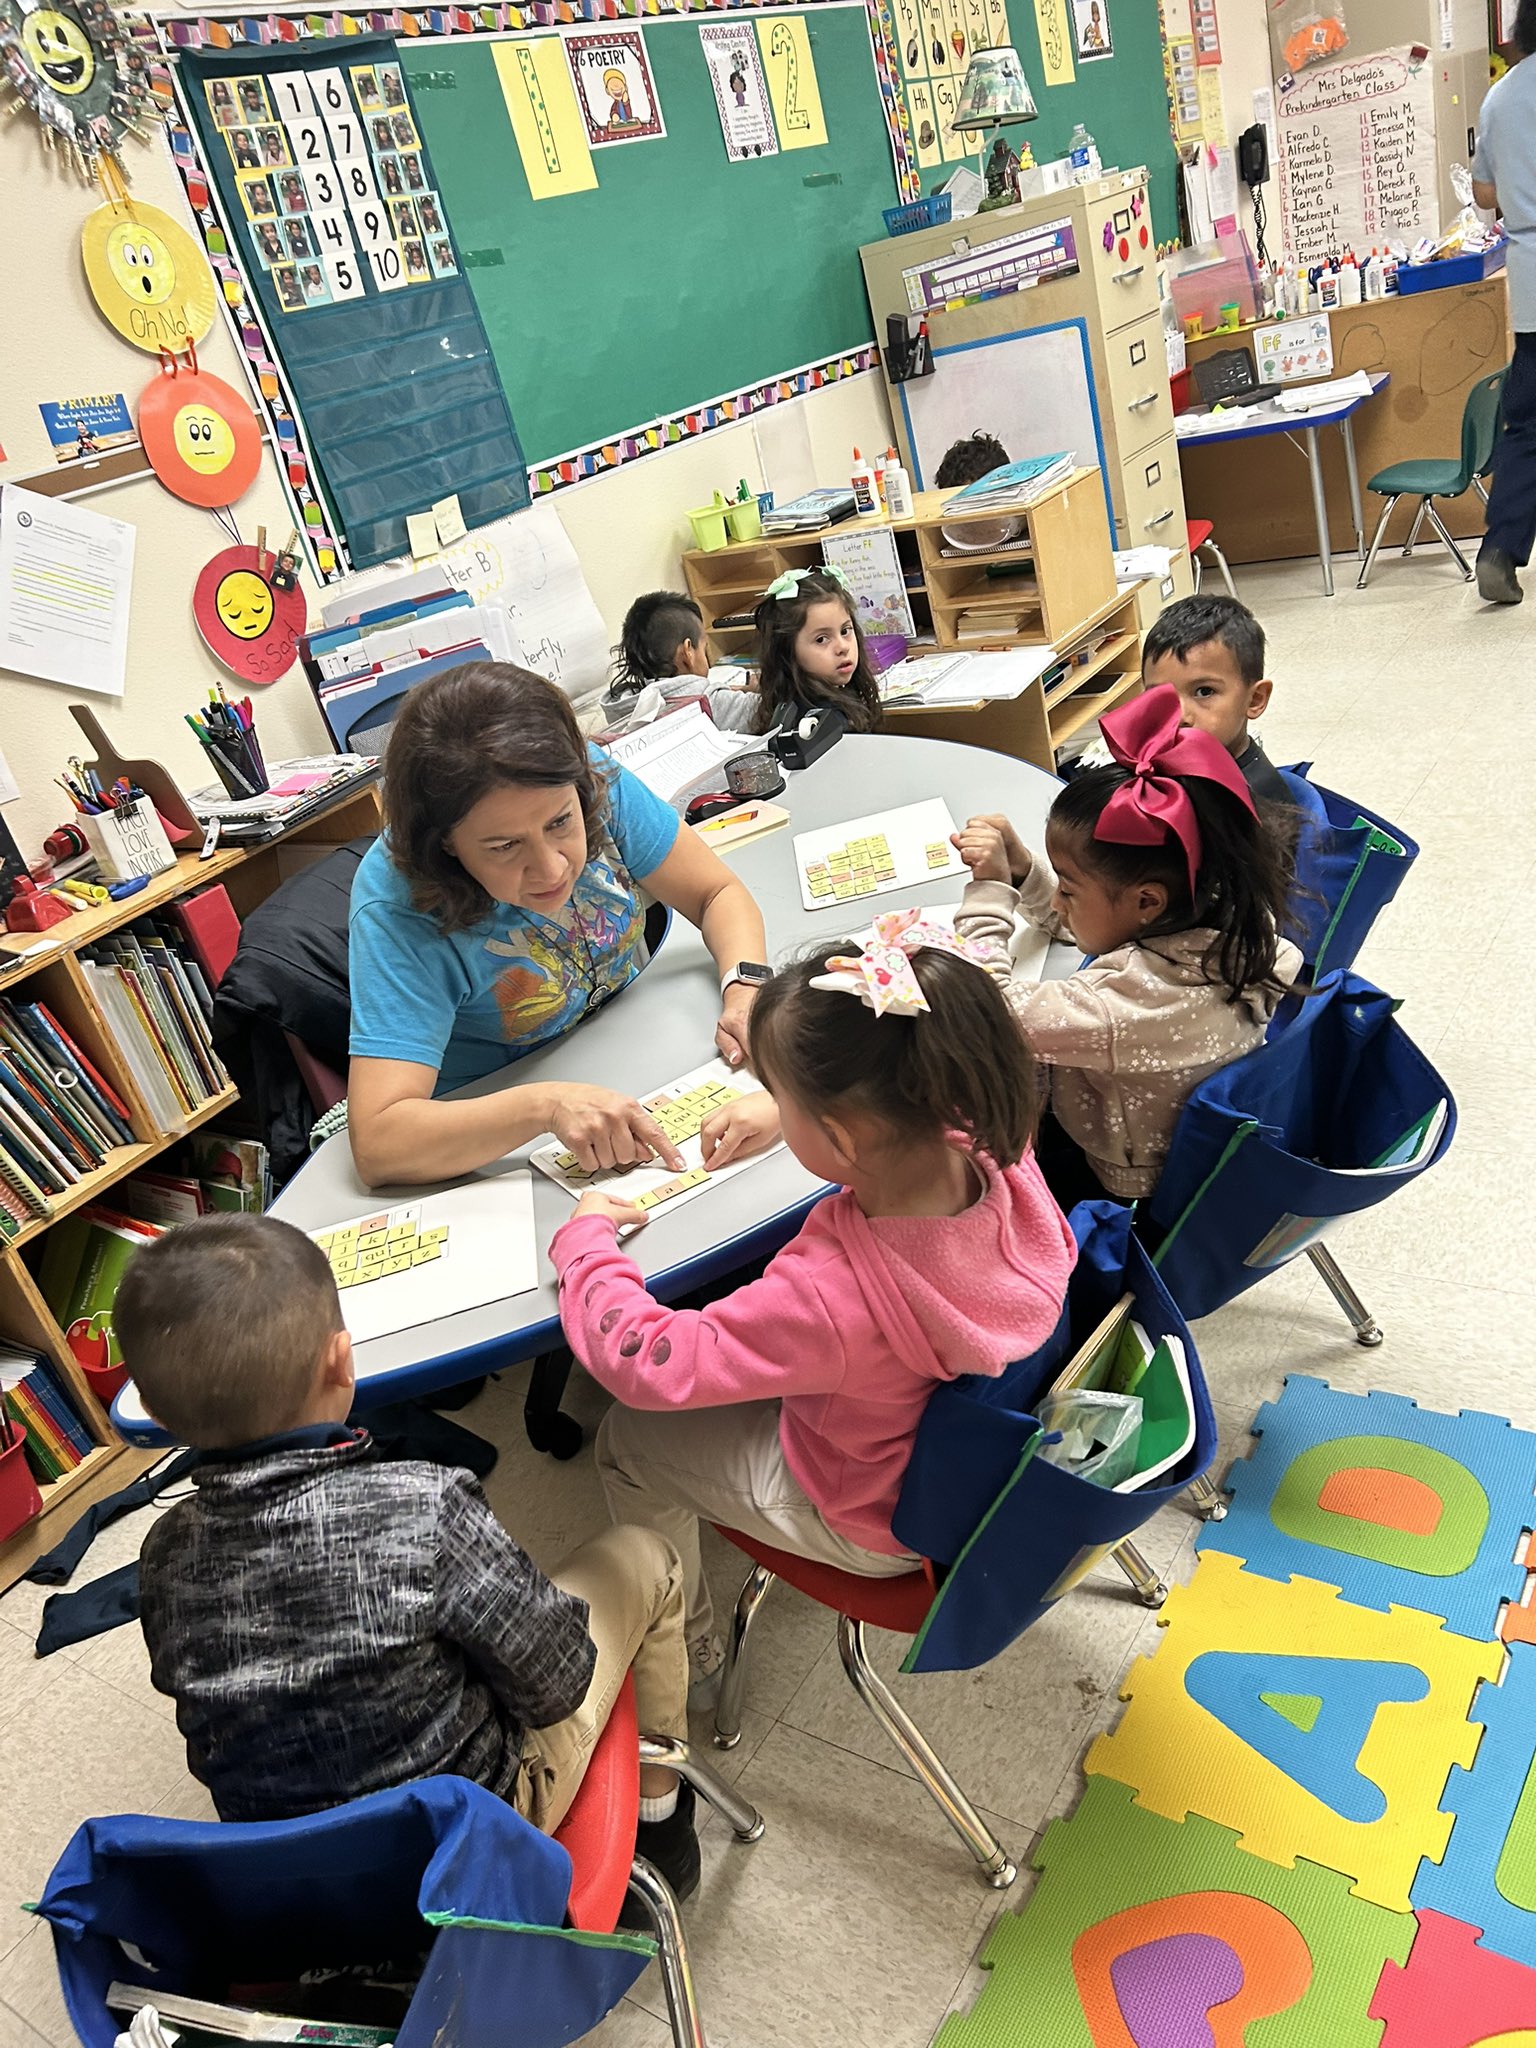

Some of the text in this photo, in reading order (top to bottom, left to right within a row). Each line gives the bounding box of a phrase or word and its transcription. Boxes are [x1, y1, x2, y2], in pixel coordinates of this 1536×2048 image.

[900, 0, 913, 31] Pp
[921, 0, 941, 20] Mm
[587, 49, 626, 68] POETRY
[770, 22, 810, 131] 2
[1318, 67, 1385, 93] Mrs Delgado's
[286, 82, 301, 113] 1
[325, 78, 341, 109] 6
[912, 88, 929, 111] Hh
[937, 83, 955, 114] Gg
[1285, 80, 1395, 116] Prekindergarten Class
[1370, 105, 1399, 123] Emily
[337, 123, 351, 154] 7
[1285, 130, 1309, 145] Evan
[1371, 121, 1405, 137] Jenessa
[301, 128, 321, 159] 2
[1287, 139, 1322, 157] Alfredo
[1373, 137, 1403, 150] Kaiden
[1288, 153, 1323, 171] Karmelo
[1373, 148, 1404, 165] Cassidy
[350, 167, 367, 197] 8
[1290, 169, 1325, 185] Mylene
[1376, 165, 1393, 179] Rey
[315, 172, 333, 203] 3
[1290, 181, 1324, 199] Kaynan
[1377, 176, 1406, 192] Dereck
[1292, 198, 1314, 212] Ian
[1379, 189, 1413, 206] Melanie
[1291, 207, 1332, 225] Mackenzie
[1378, 205, 1410, 220] Thiago
[321, 217, 343, 247] 4
[364, 211, 379, 240] 9
[1294, 221, 1329, 239] Jessiah
[1294, 236, 1324, 251] Ember
[373, 247, 400, 282] 10
[1297, 244, 1341, 265] Esmeralda
[335, 260, 352, 290] 5
[129, 305, 193, 340] Oh No!
[1261, 333, 1282, 354] Ff
[57, 394, 118, 411] PRIMARY
[842, 543, 862, 553] Letter
[474, 551, 492, 573] B
[245, 619, 300, 676] So Sad
[121, 828, 155, 857] LOVE
[126, 847, 168, 879] INSPIRE
[672, 1111, 693, 1125] qu
[341, 1230, 352, 1240] d
[367, 1236, 378, 1245] k
[364, 1249, 386, 1261] qu
[401, 1241, 410, 1249] r
[361, 1271, 373, 1279] x
[392, 1258, 403, 1269] y
[420, 1250, 431, 1258] z
[1269, 1434, 1491, 1578] D
[1184, 1649, 1431, 1824] A
